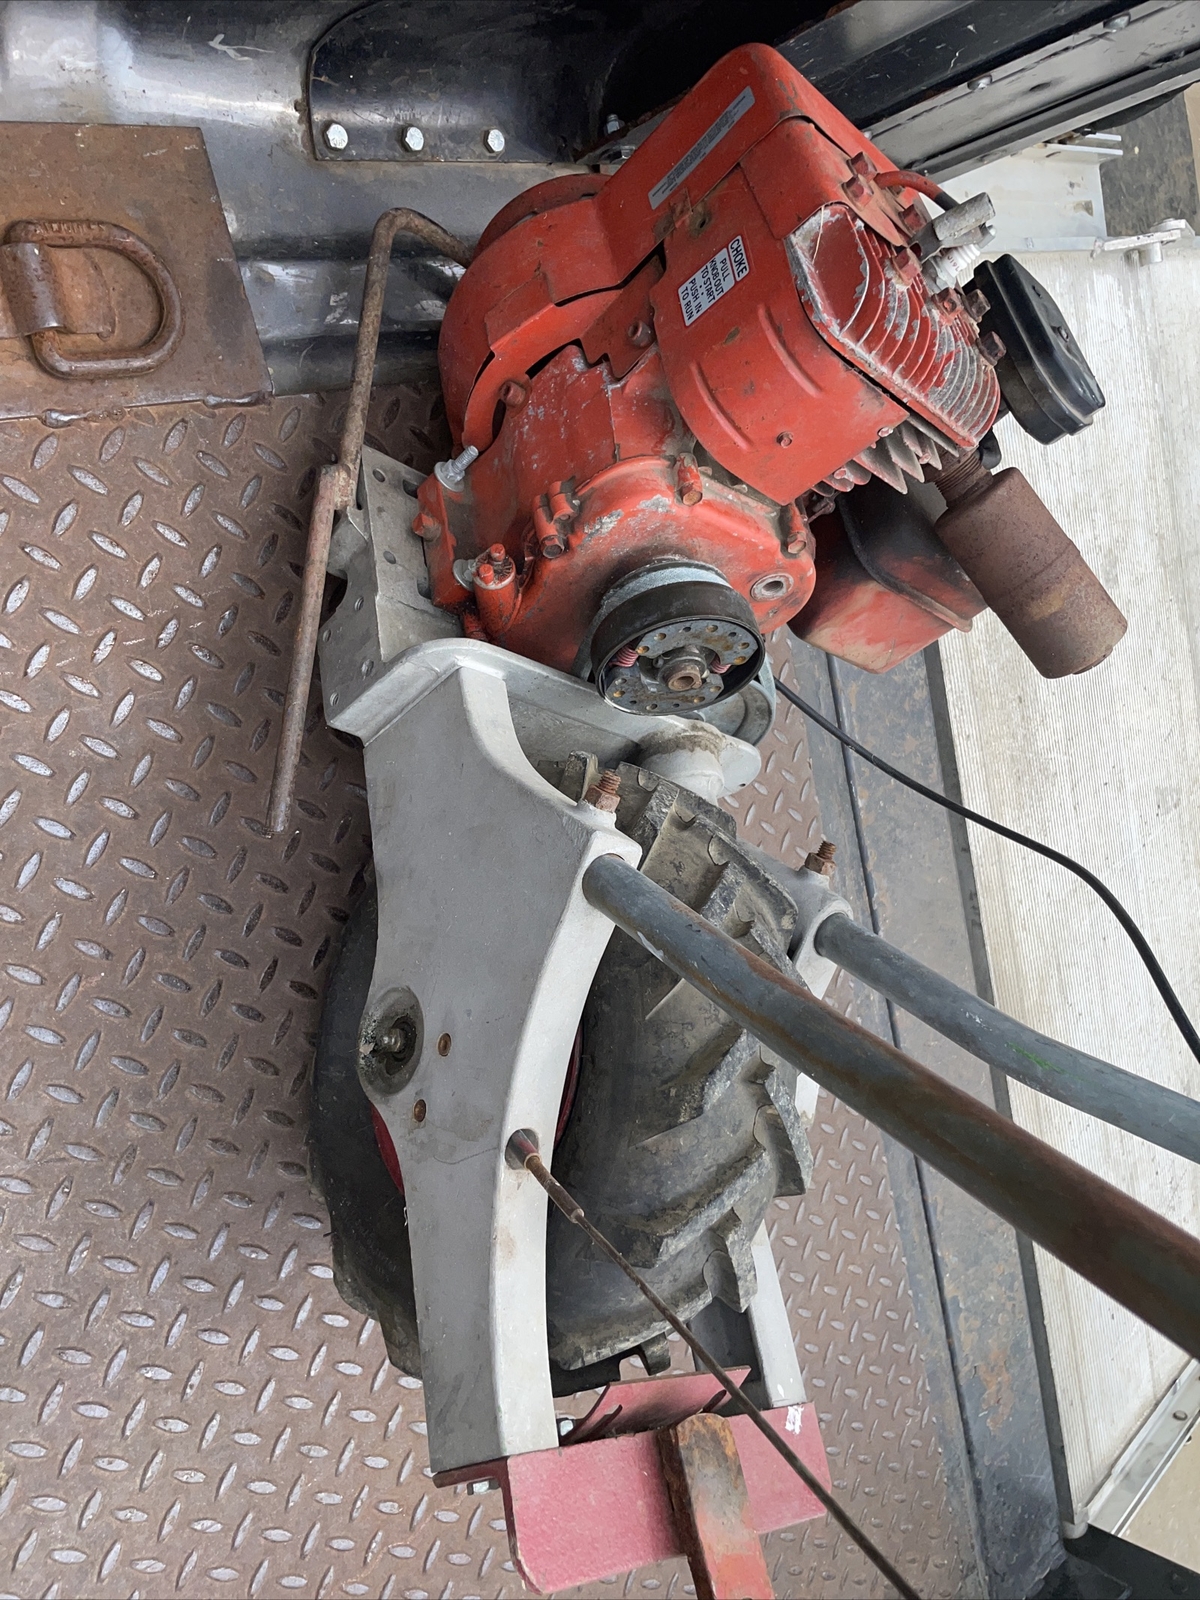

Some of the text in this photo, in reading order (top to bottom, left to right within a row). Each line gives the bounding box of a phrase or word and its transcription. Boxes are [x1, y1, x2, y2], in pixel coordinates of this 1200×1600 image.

[720, 258, 730, 282] PULL
[730, 238, 747, 278] CHOKE
[689, 277, 703, 314] PUSH IN
[701, 265, 715, 303] TO START
[709, 258, 724, 296] KNOB OUT
[681, 286, 694, 320] TO RUN
